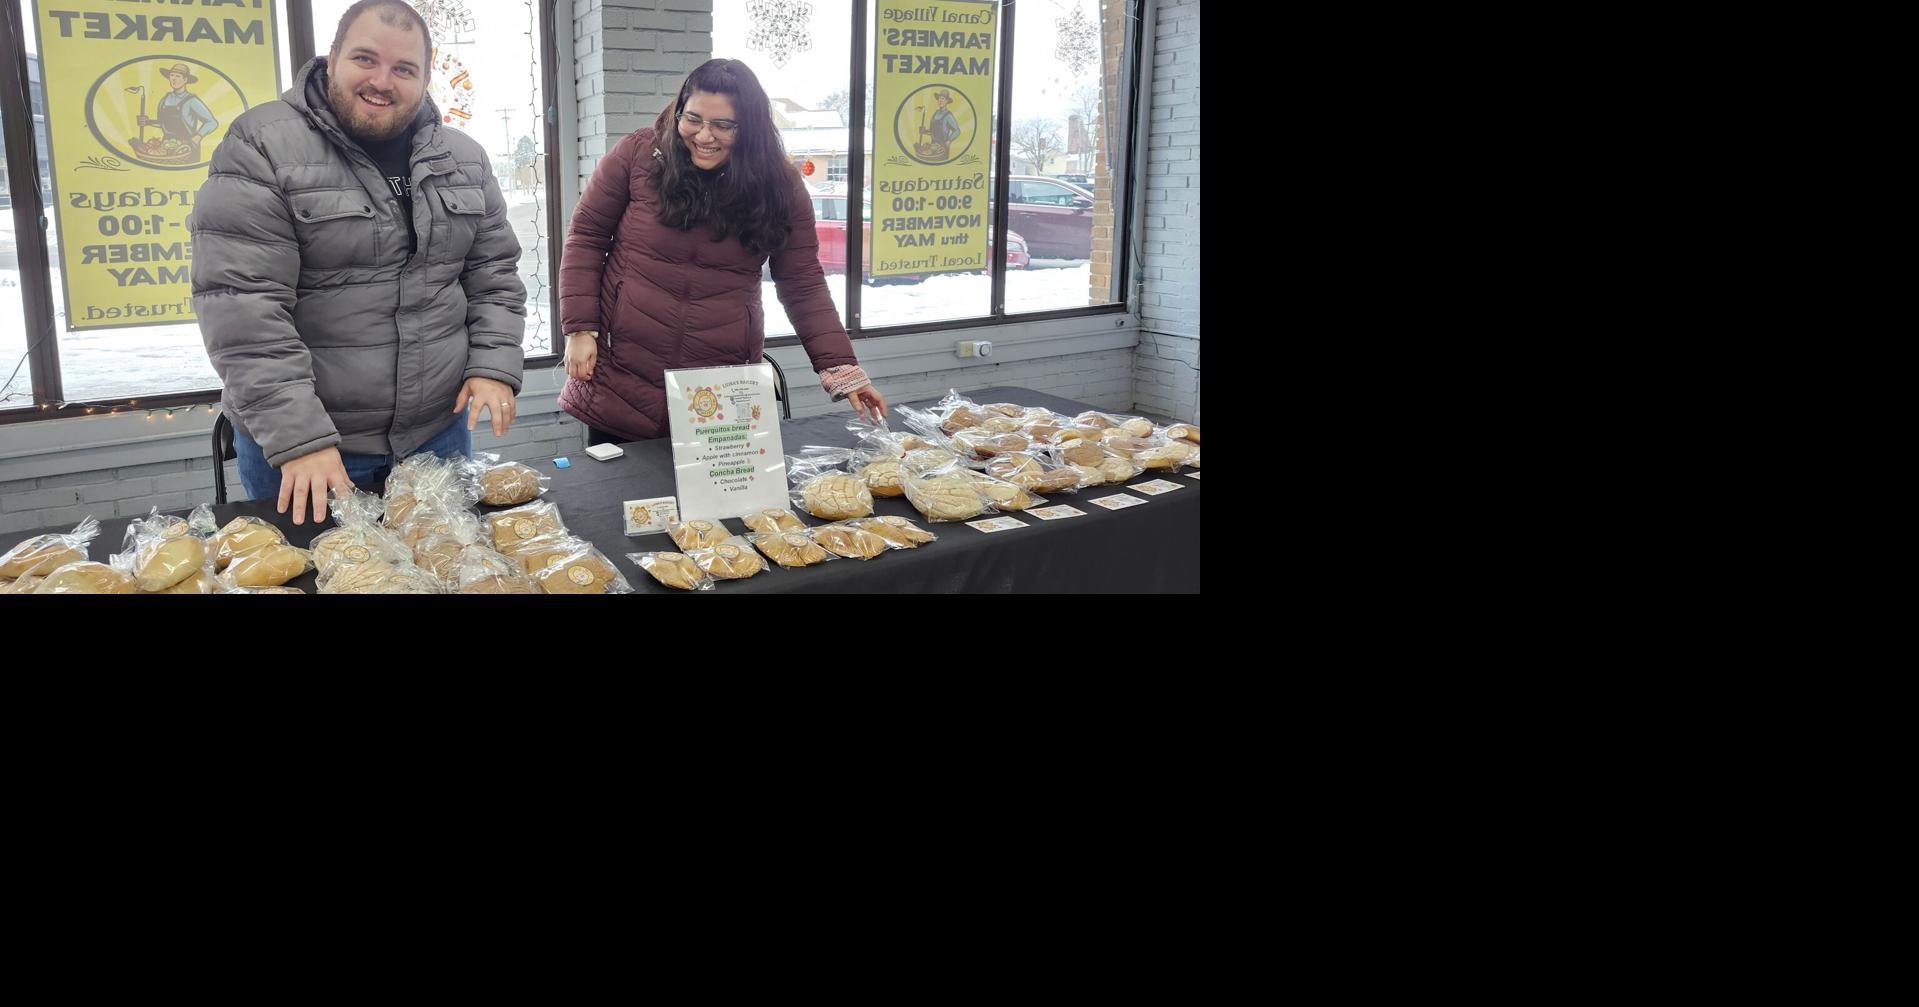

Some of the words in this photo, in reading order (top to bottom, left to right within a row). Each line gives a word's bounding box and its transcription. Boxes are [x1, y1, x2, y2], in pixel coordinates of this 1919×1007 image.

[695, 425, 730, 436] Puerquitos
[731, 424, 750, 432] bread
[714, 443, 745, 451] Strawberry
[718, 459, 745, 467] Pineapple
[709, 469, 735, 478] Concha
[736, 466, 755, 475] Bread
[720, 477, 748, 485] Chocolate
